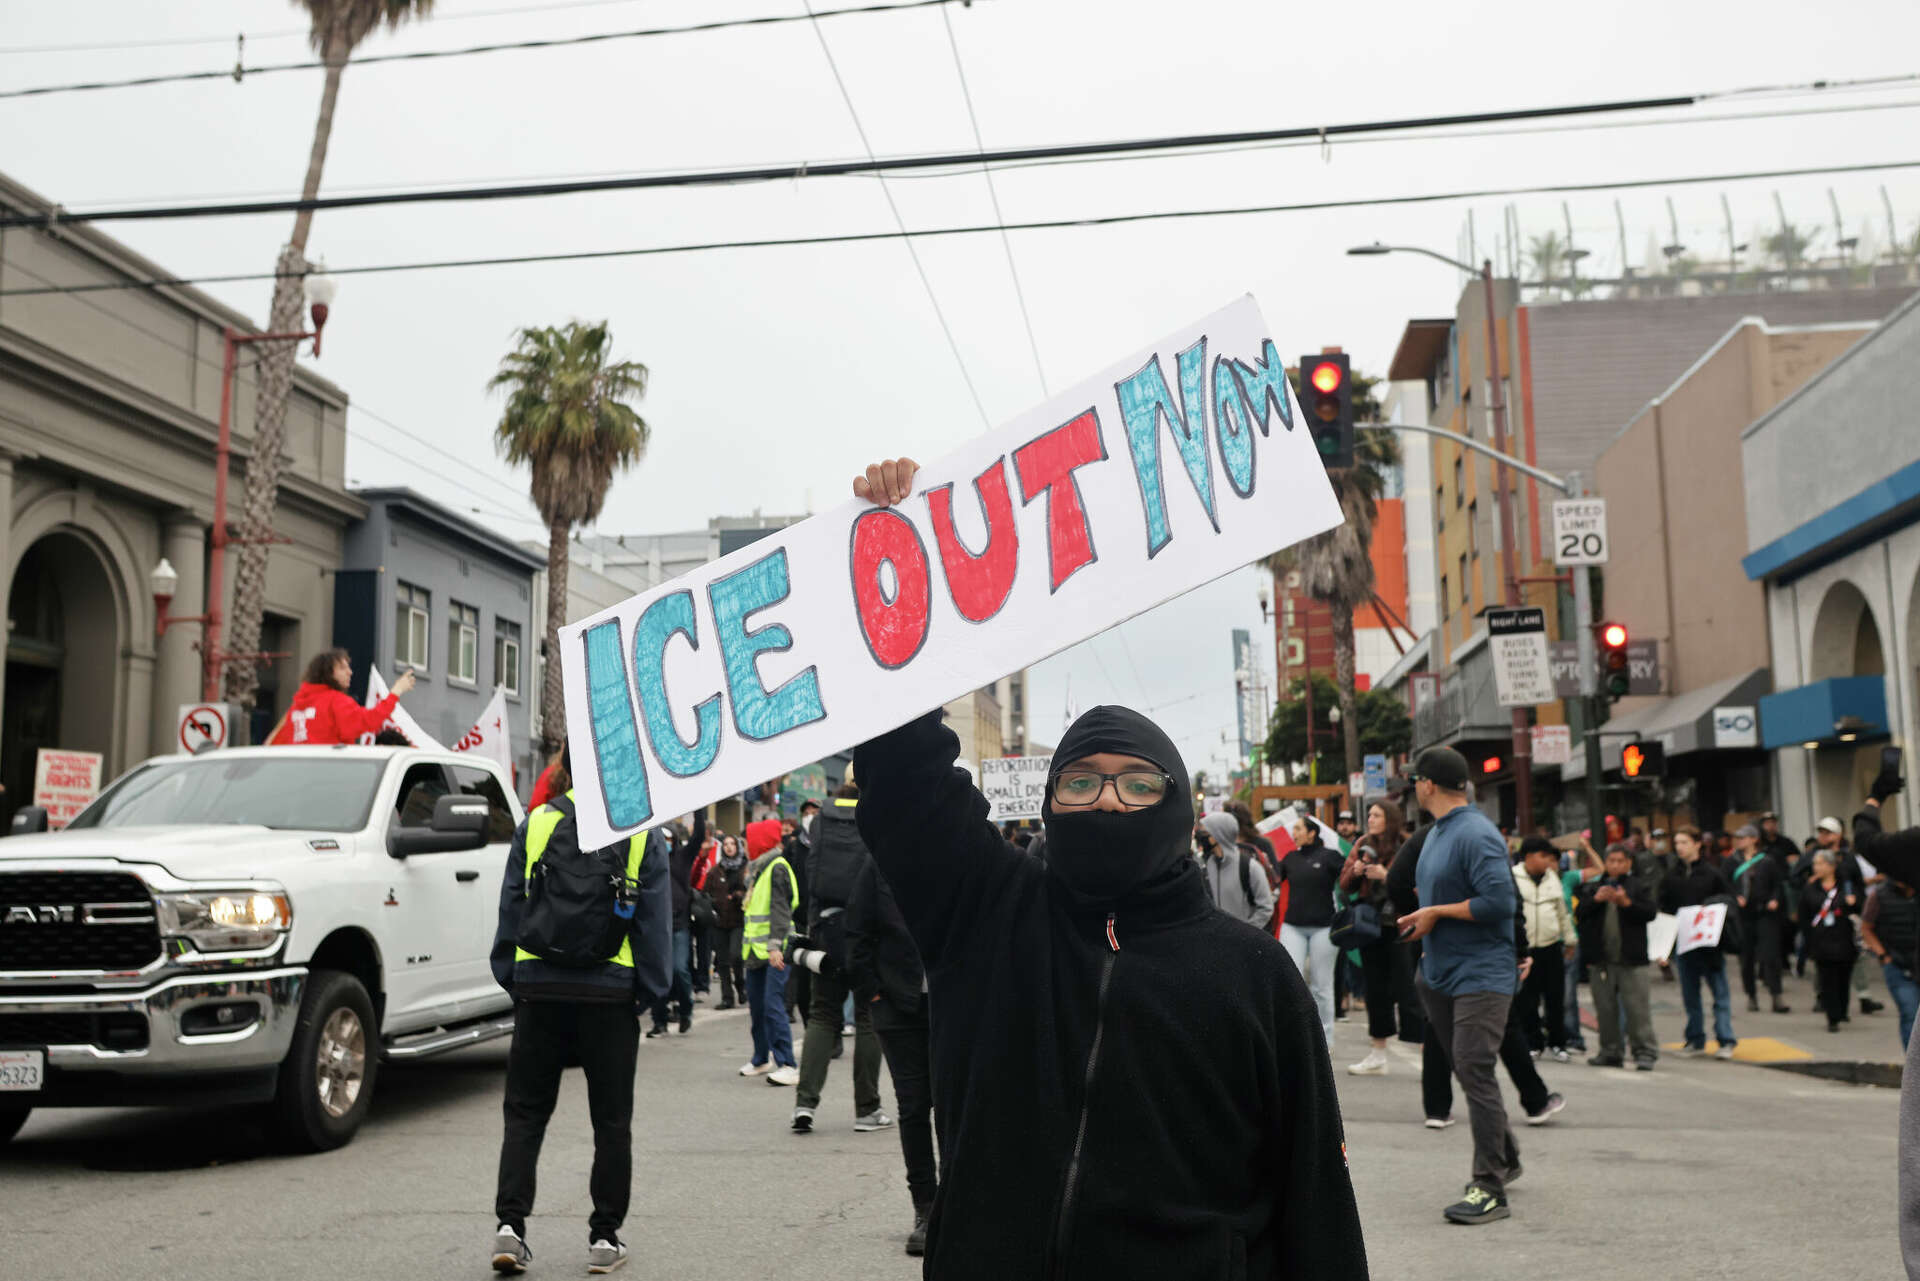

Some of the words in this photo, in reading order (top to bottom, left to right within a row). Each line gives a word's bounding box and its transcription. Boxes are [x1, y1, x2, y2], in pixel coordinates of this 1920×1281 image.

[1556, 505, 1602, 518] SPEED
[1561, 519, 1598, 531] LIMIT
[1560, 533, 1602, 557] 20
[578, 545, 828, 832] ICE
[849, 405, 1109, 671] OUT
[1491, 616, 1516, 627] RIGHT
[1518, 615, 1541, 626] LANE
[1503, 638, 1534, 648] BUSES
[1507, 659, 1535, 669] RIGHT
[1507, 670, 1538, 680] TURNS
[46, 773, 91, 789] RIGHTS
[1009, 774, 1021, 786] IS
[986, 785, 1023, 800] SMALL
[1025, 783, 1046, 797] DIC
[998, 799, 1041, 814] ENERGY
